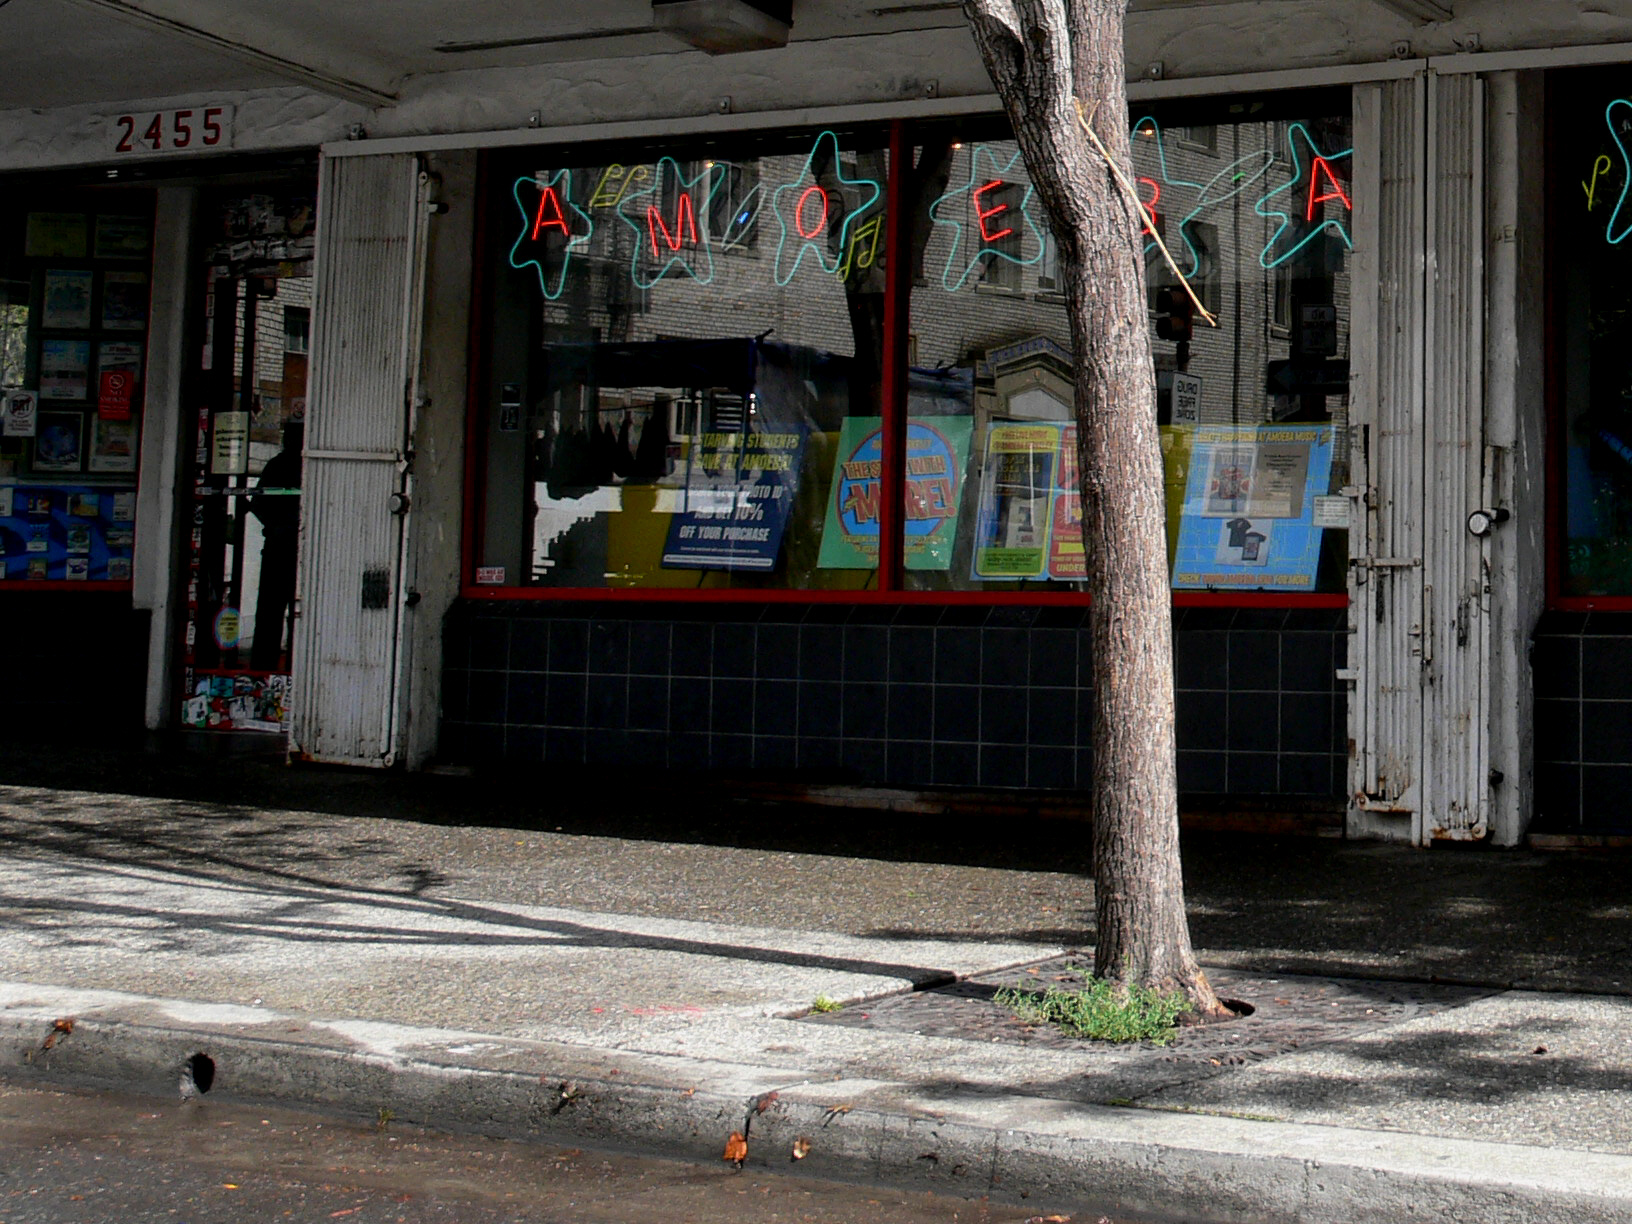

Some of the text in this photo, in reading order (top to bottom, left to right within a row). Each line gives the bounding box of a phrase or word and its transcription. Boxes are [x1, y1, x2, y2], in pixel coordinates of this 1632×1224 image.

[115, 107, 222, 153] 2455
[747, 434, 800, 449] STUDENTS
[842, 461, 870, 480] THE
[850, 478, 956, 524] MRE!
[679, 525, 770, 542] OFF YOUR PURCHASE
